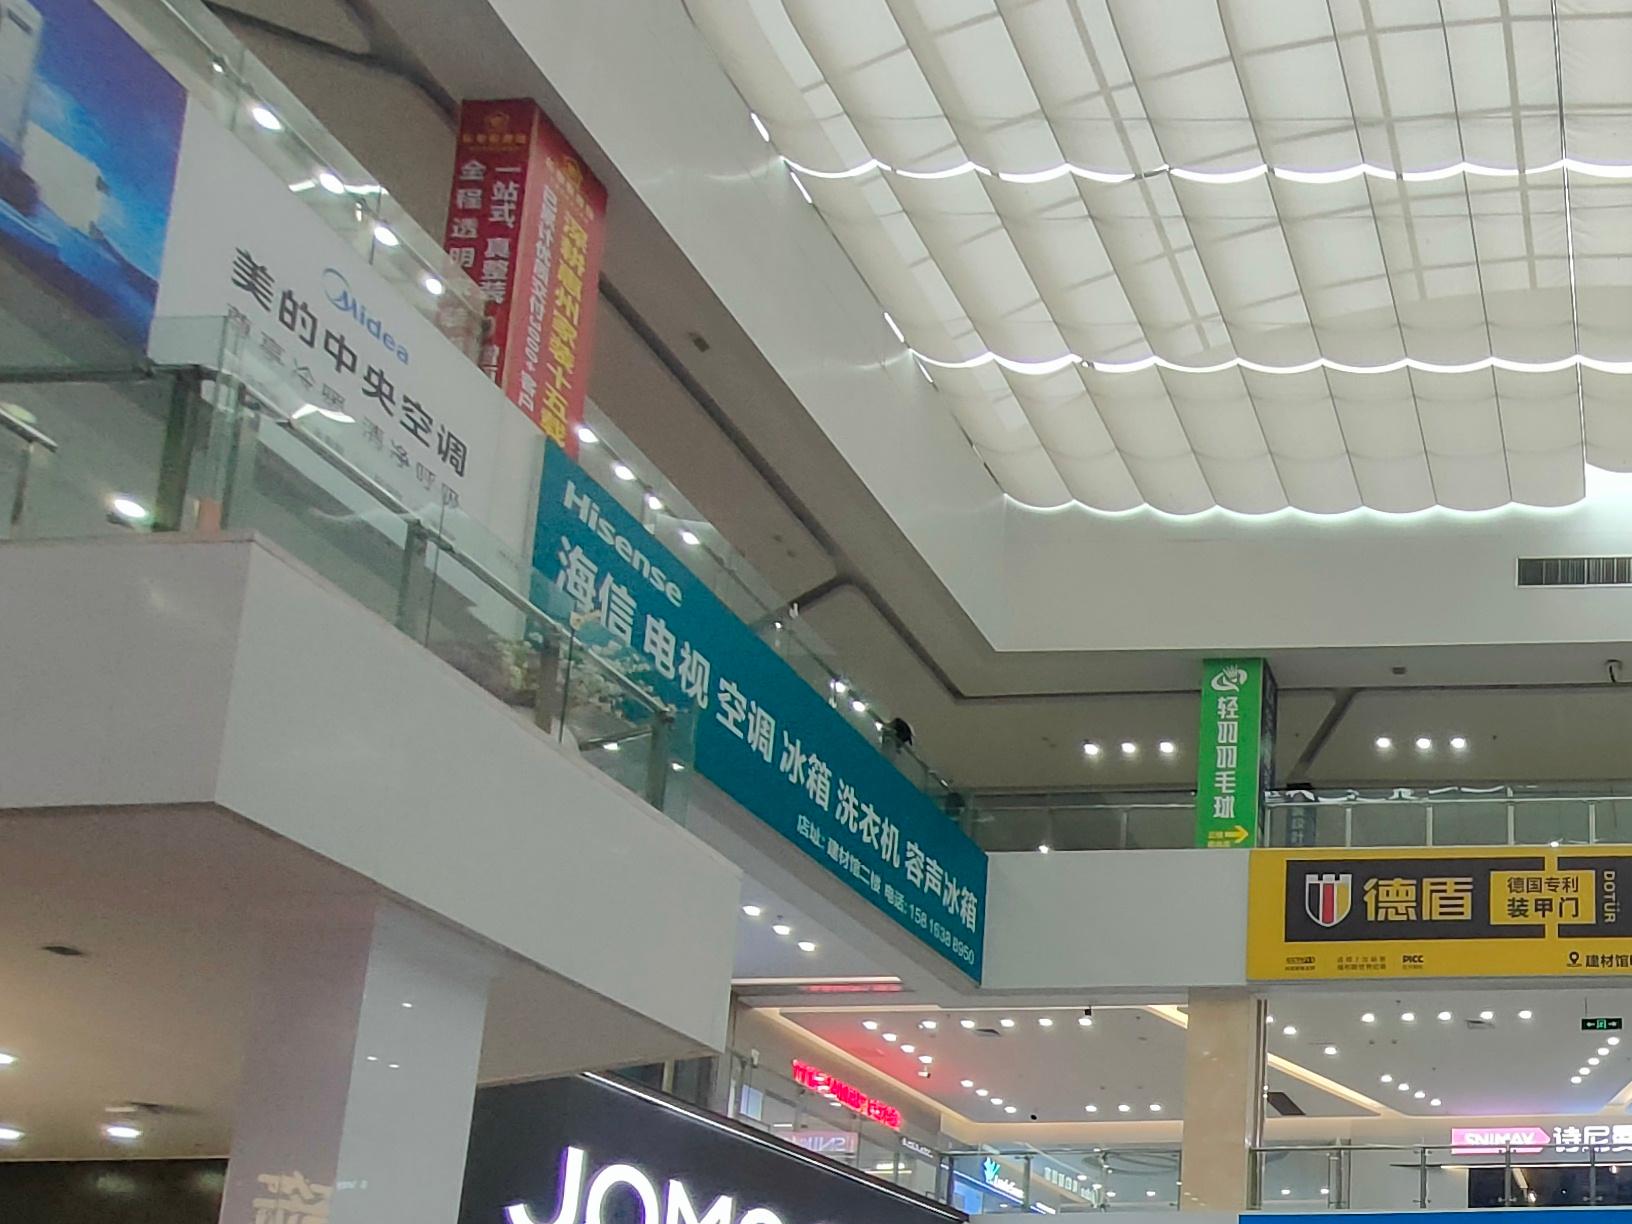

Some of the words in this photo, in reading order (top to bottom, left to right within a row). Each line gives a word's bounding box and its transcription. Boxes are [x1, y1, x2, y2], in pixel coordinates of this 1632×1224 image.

[329, 285, 410, 366] Midea
[231, 247, 468, 478] 美的中央空调
[562, 480, 684, 608] Hisense
[556, 536, 638, 648] 海信
[643, 612, 712, 709] 电视
[715, 676, 776, 764] 空调
[779, 730, 833, 813] 冰箱
[835, 777, 901, 869] 洗衣机
[904, 840, 979, 933] 容声冰箱
[1363, 876, 1474, 922] 德盾
[1506, 876, 1580, 894] 德国专利
[1506, 897, 1580, 918] 装甲门
[909, 904, 928, 929] 158
[952, 937, 975, 965] 8950
